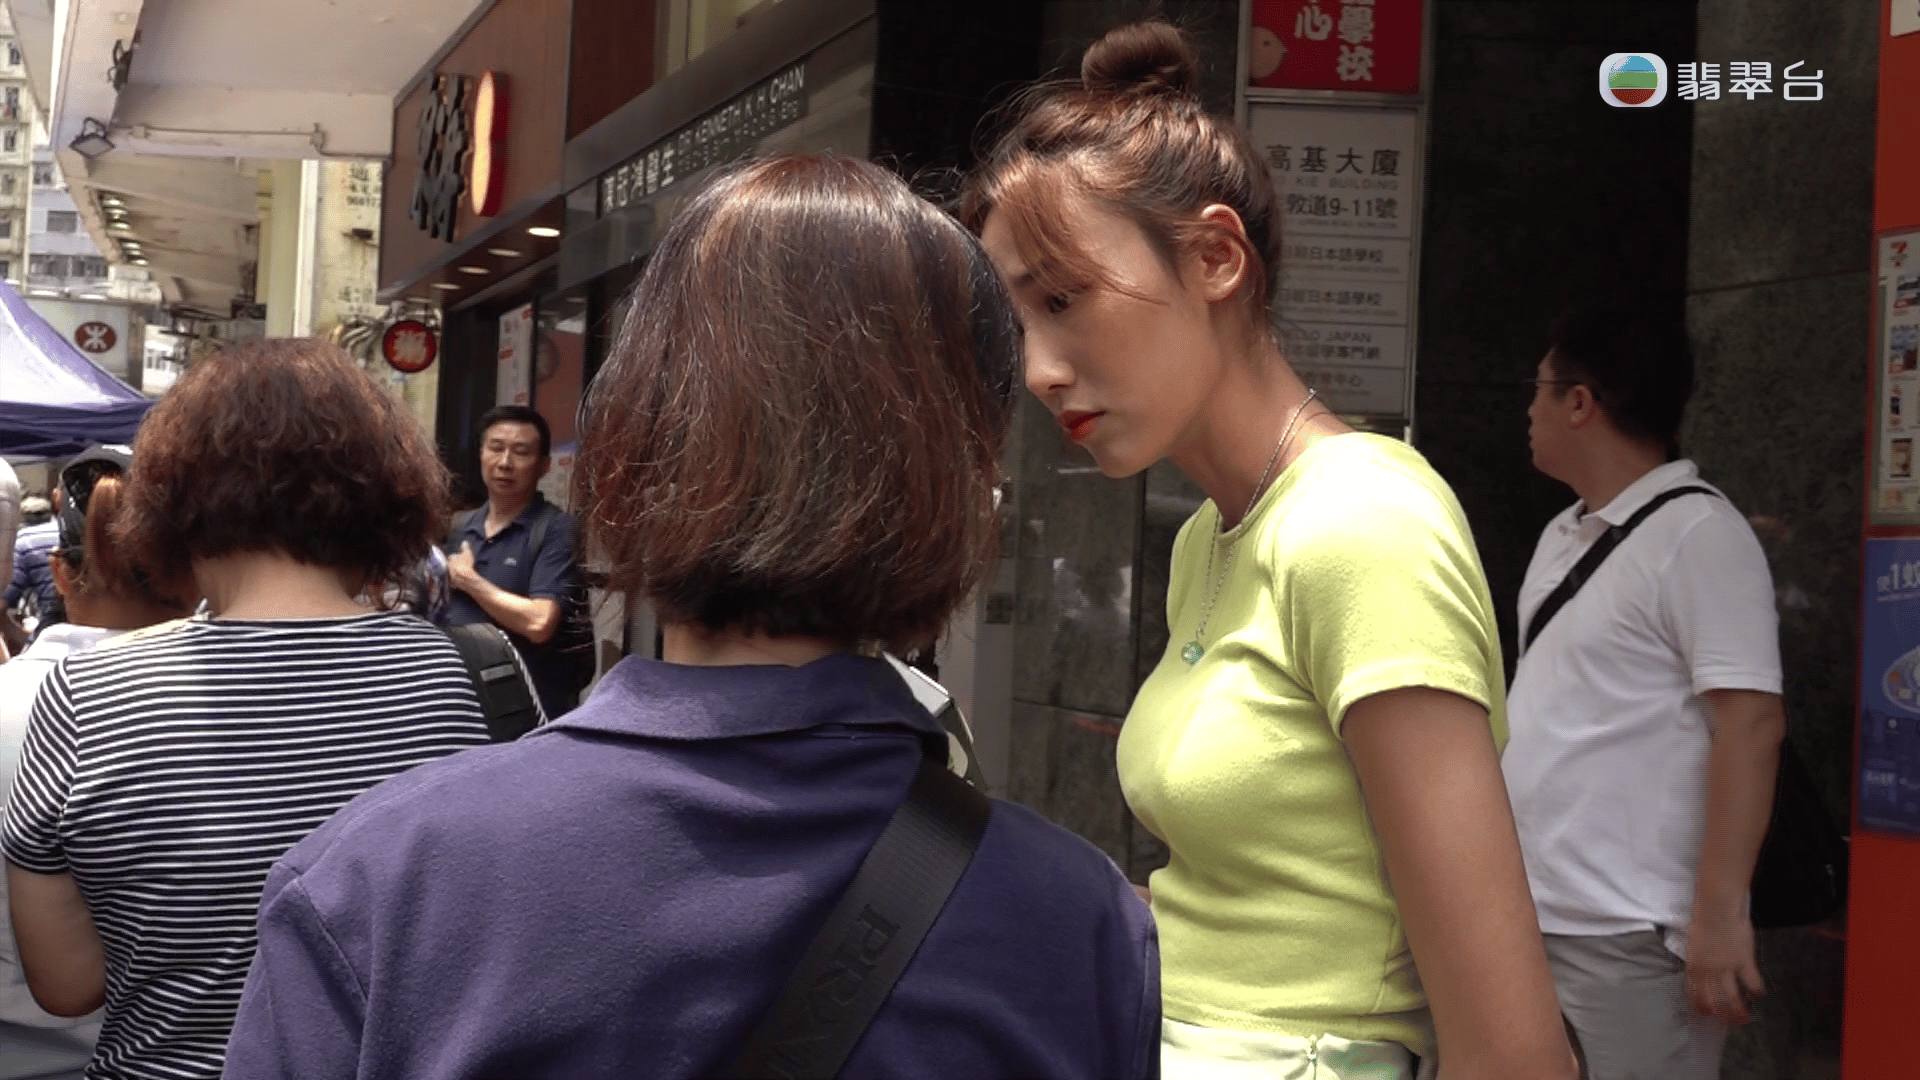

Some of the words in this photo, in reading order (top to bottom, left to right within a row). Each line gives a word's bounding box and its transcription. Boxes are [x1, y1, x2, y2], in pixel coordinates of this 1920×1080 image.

[1293, 0, 1332, 41] 心
[769, 65, 804, 103] CHAN
[1266, 144, 1400, 176] 高基大廈
